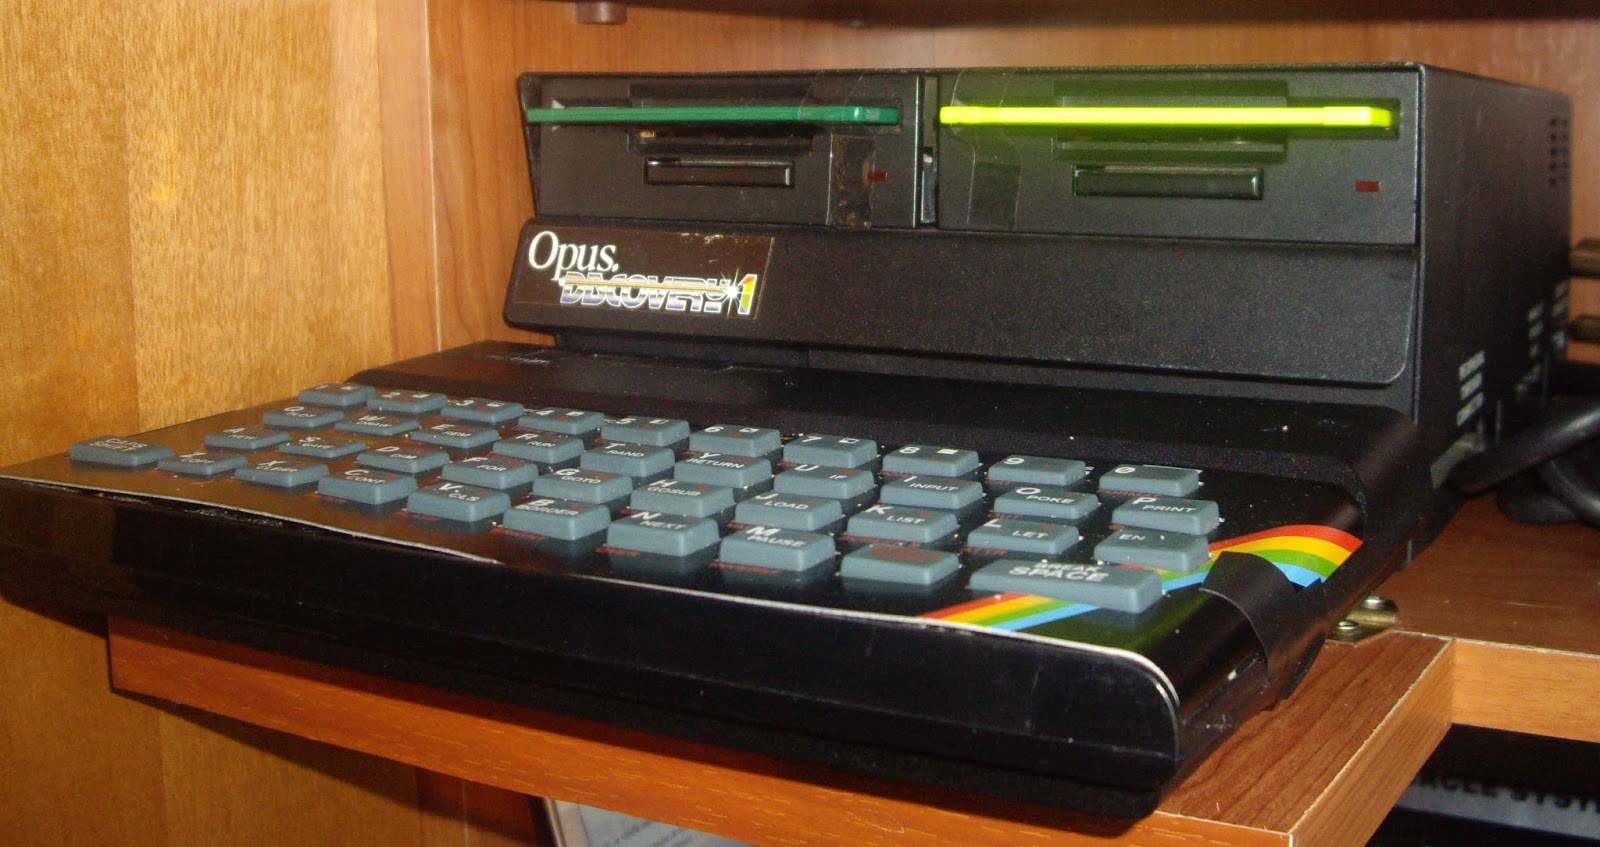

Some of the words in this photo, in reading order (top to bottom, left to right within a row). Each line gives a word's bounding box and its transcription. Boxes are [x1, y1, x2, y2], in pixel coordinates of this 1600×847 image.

[615, 417, 637, 425] 5
[431, 423, 456, 431] E
[802, 435, 823, 443] 7
[526, 440, 557, 448] RUN
[605, 450, 646, 458] RAND
[899, 446, 920, 454] 8
[699, 452, 722, 460] Y
[686, 458, 745, 469] RETURN
[1003, 457, 1025, 465] 9
[555, 468, 580, 477] G
[794, 464, 820, 472] U
[344, 469, 370, 477] C
[345, 475, 387, 484] CONT
[561, 475, 602, 485] GOTO
[650, 479, 678, 488] H
[909, 482, 960, 492] INPUT
[646, 487, 701, 497] GOSUB
[448, 493, 481, 501] CLS
[755, 493, 778, 501] J
[1025, 495, 1076, 504] POKE
[1132, 497, 1157, 505] P
[526, 499, 555, 507] B
[764, 500, 809, 510] LOAD
[864, 505, 893, 515] K
[1142, 504, 1196, 513] PRINT
[630, 511, 661, 520] N
[886, 515, 926, 524] LIST
[639, 520, 687, 530] NEXT
[982, 519, 1002, 528] L
[745, 525, 781, 536] M
[1011, 530, 1049, 538] LET
[747, 535, 807, 547] PAUSE
[1008, 566, 1110, 582] SPACE
